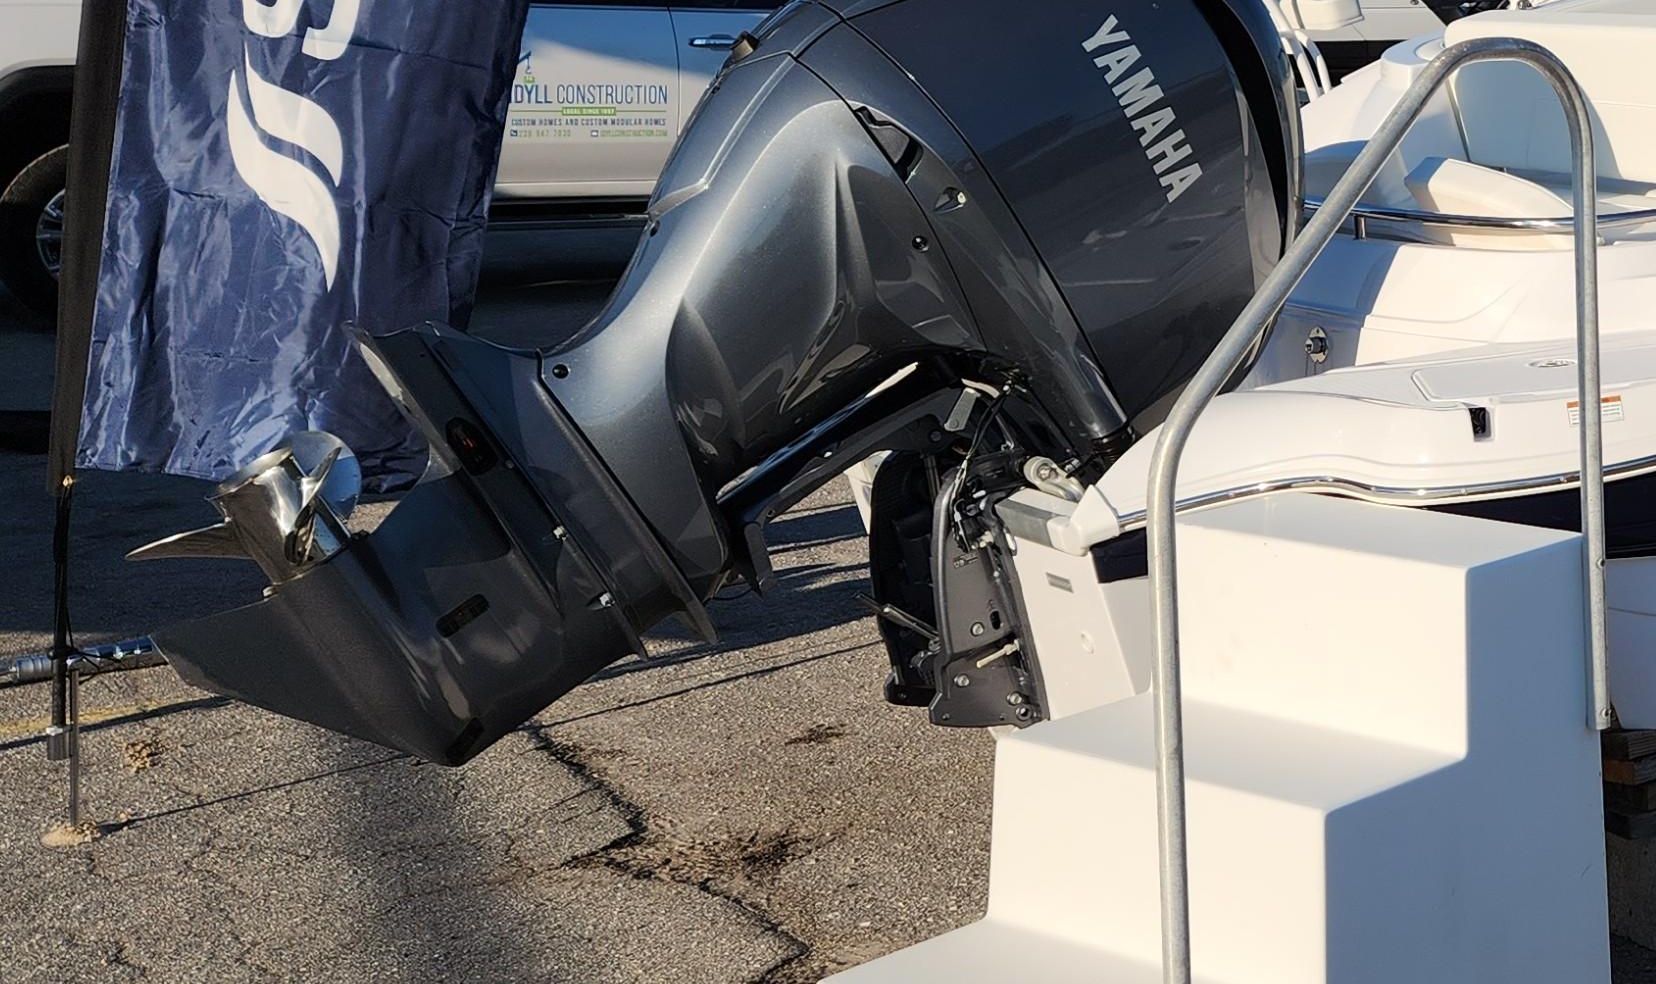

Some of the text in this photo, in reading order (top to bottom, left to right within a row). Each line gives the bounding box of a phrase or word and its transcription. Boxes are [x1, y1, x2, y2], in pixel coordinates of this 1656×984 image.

[510, 84, 668, 105] DYLL CONSTRUCTION
[1081, 14, 1203, 203] YAMAHA
